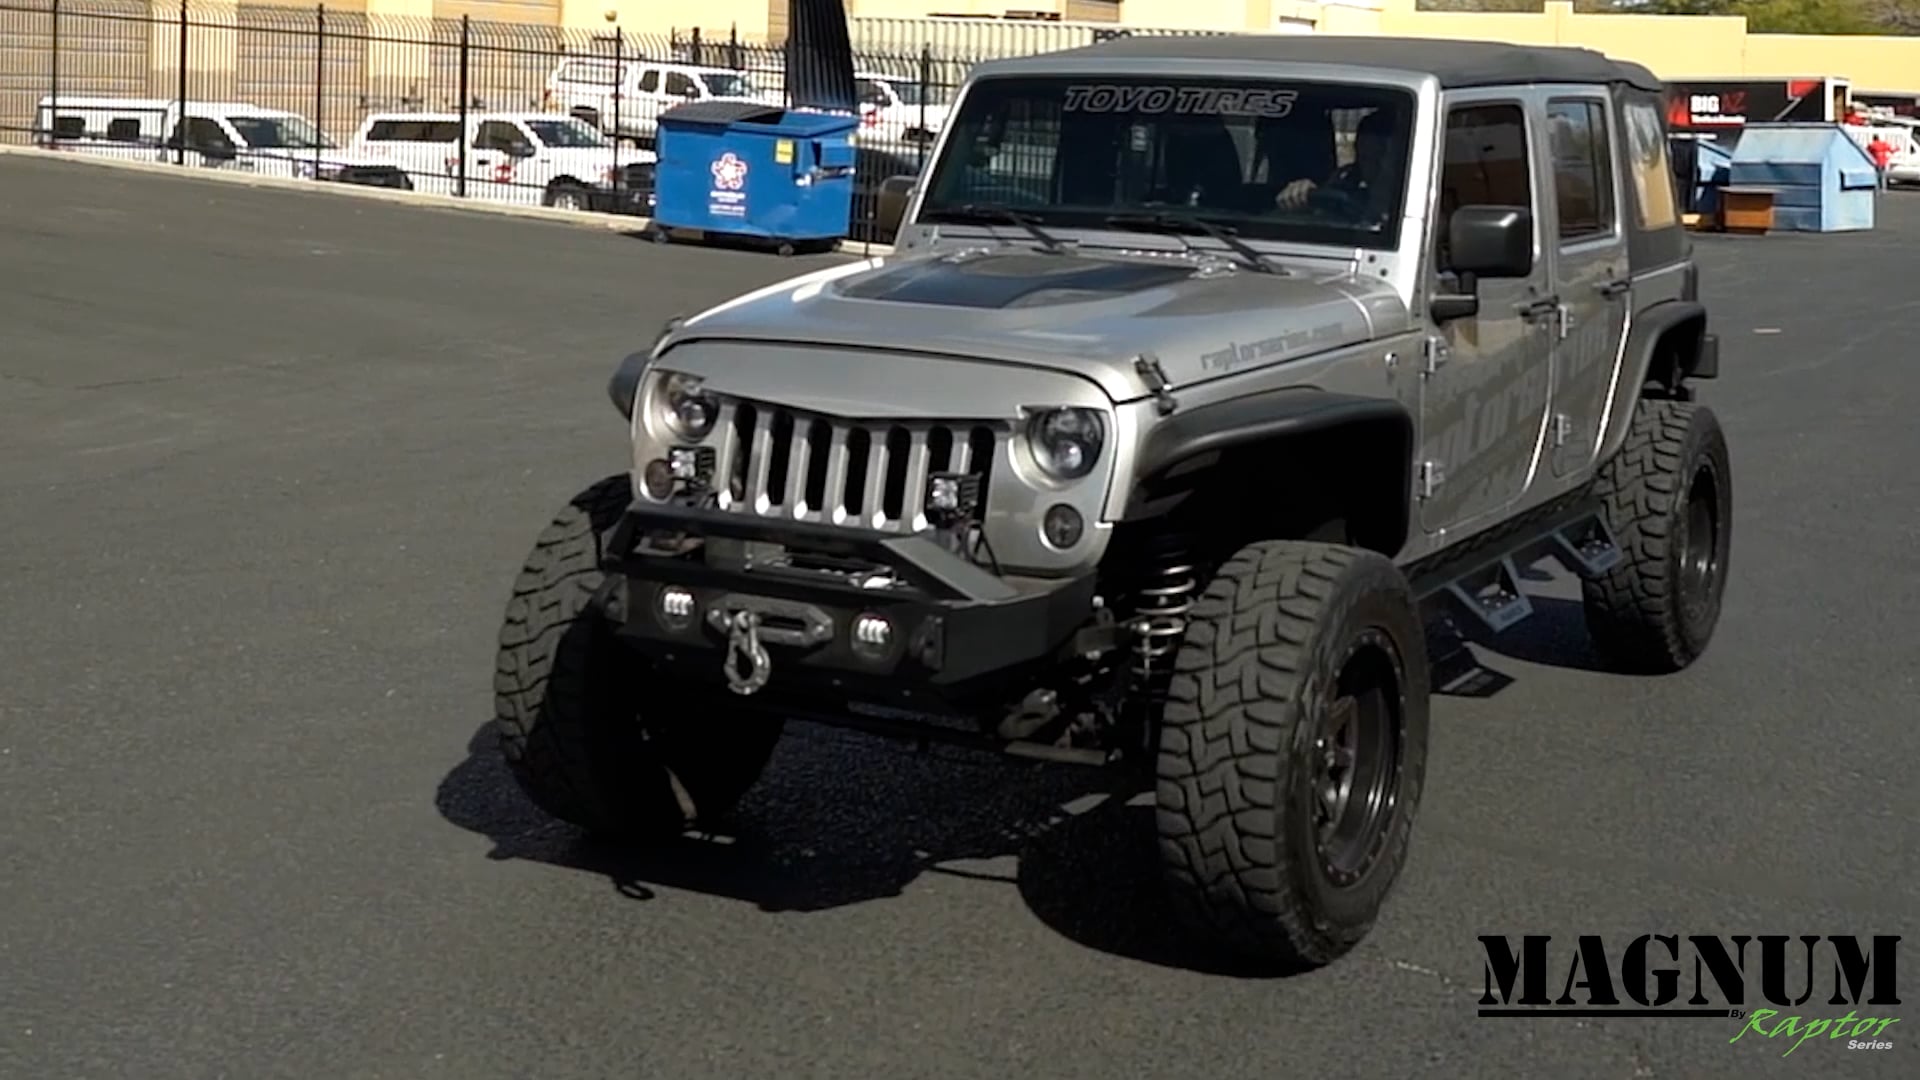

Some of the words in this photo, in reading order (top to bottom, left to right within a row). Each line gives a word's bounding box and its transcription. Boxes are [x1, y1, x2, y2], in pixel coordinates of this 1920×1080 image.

[1063, 85, 1176, 113] TOYO
[1174, 87, 1299, 118] TIRES
[1690, 94, 1720, 113] BIG
